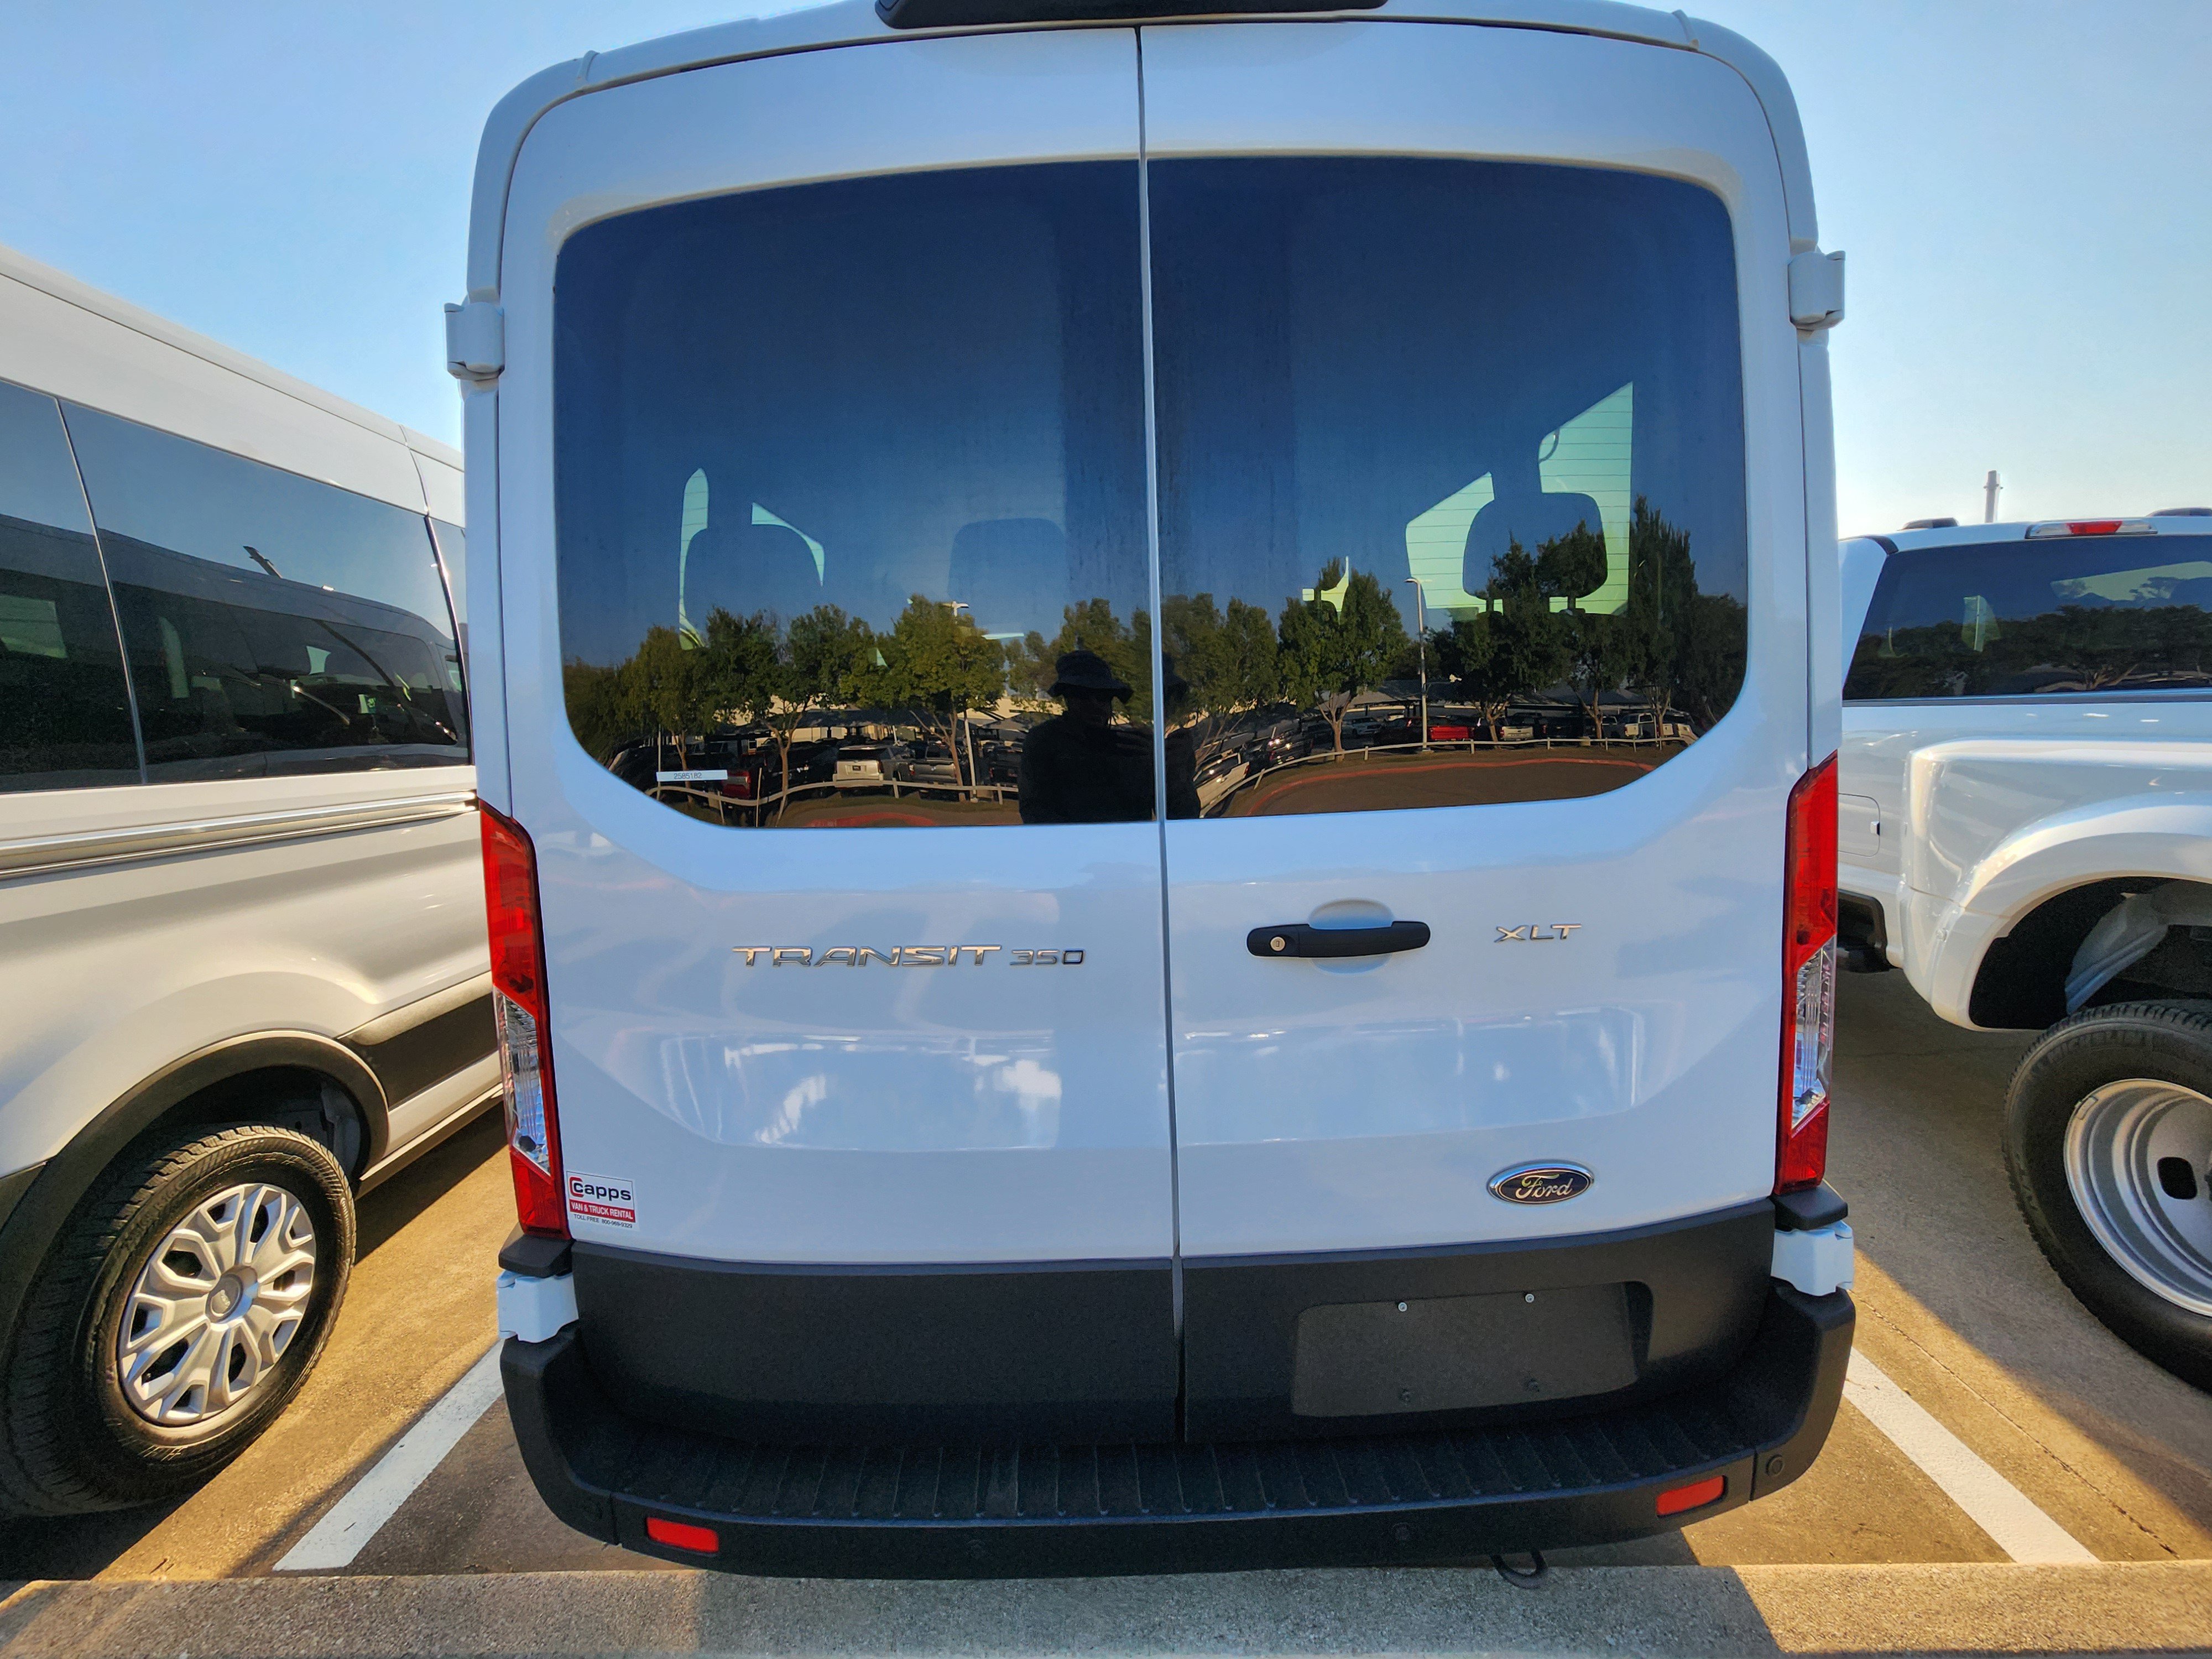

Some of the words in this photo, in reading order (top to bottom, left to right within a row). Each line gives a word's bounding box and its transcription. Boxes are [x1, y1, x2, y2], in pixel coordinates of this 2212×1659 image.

[1493, 923, 1582, 943] XLT
[731, 944, 1002, 967] TRANSIT
[1009, 948, 1086, 967] 350
[1515, 1173, 1574, 1199] Ford
[571, 1202, 583, 1211] VAN
[588, 1204, 609, 1215] TRUCK
[609, 1208, 634, 1220] RENTAL
